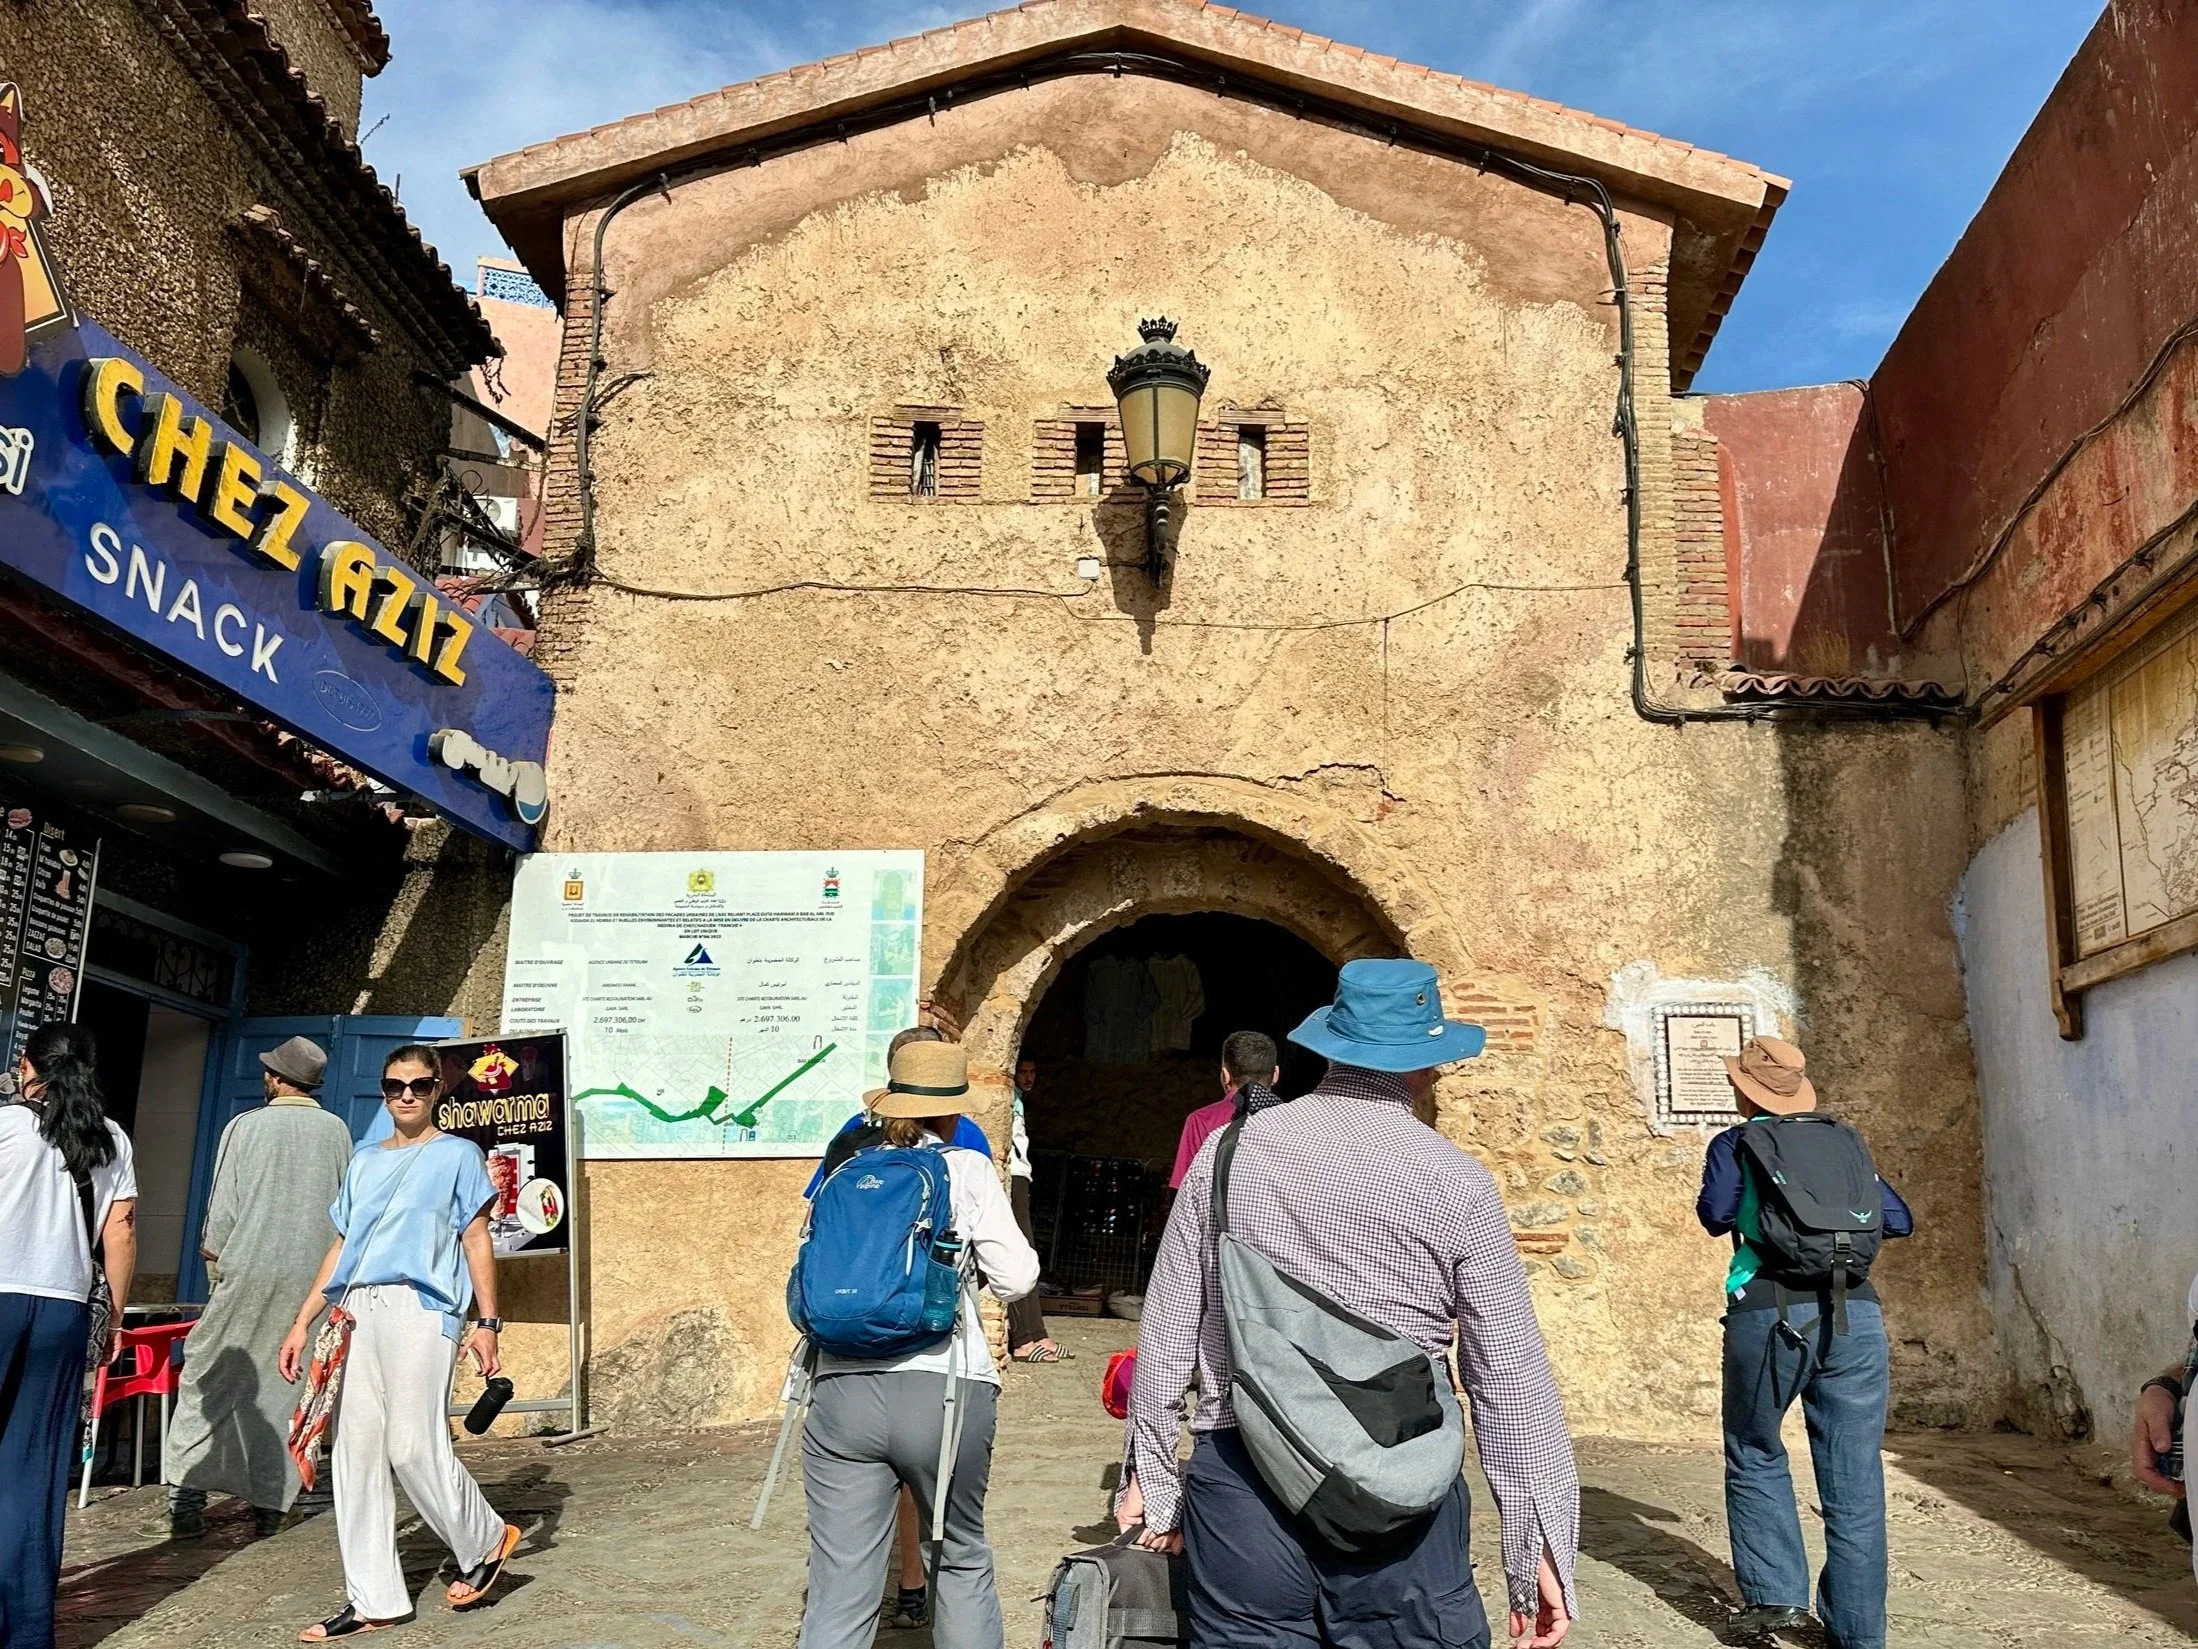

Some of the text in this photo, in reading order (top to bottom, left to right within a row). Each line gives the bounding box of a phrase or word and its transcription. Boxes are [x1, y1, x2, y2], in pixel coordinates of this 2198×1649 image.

[90, 357, 474, 687] CHEZ AZIZ
[85, 522, 285, 685] SNACK
[22, 967, 36, 979] Pizza
[438, 1093, 550, 1131] shawarma
[498, 1121, 553, 1137] CHEZ AZIZ
